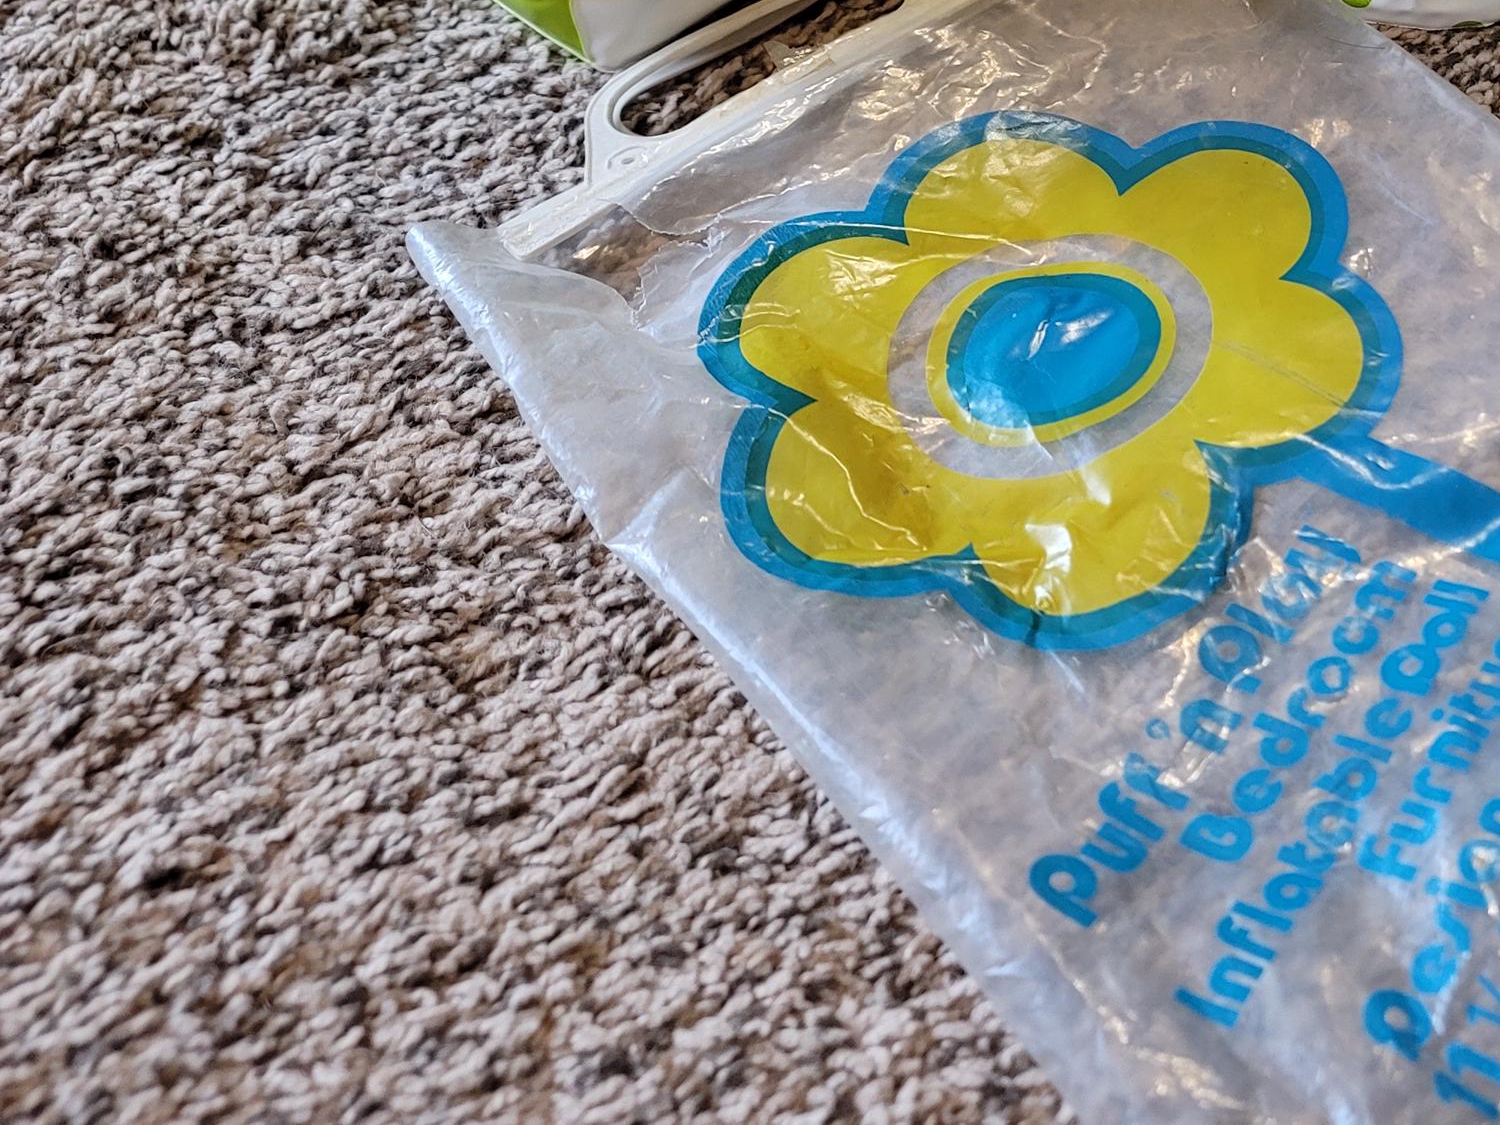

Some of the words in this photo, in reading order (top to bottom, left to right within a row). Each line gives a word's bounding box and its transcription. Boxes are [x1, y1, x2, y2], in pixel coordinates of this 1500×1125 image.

[1029, 752, 1190, 928] Puff
[1198, 525, 1361, 694] Play
[1173, 696, 1413, 1027] Inflatable
[1379, 578, 1490, 697] Doll
[1179, 560, 1417, 862] Bedroom
